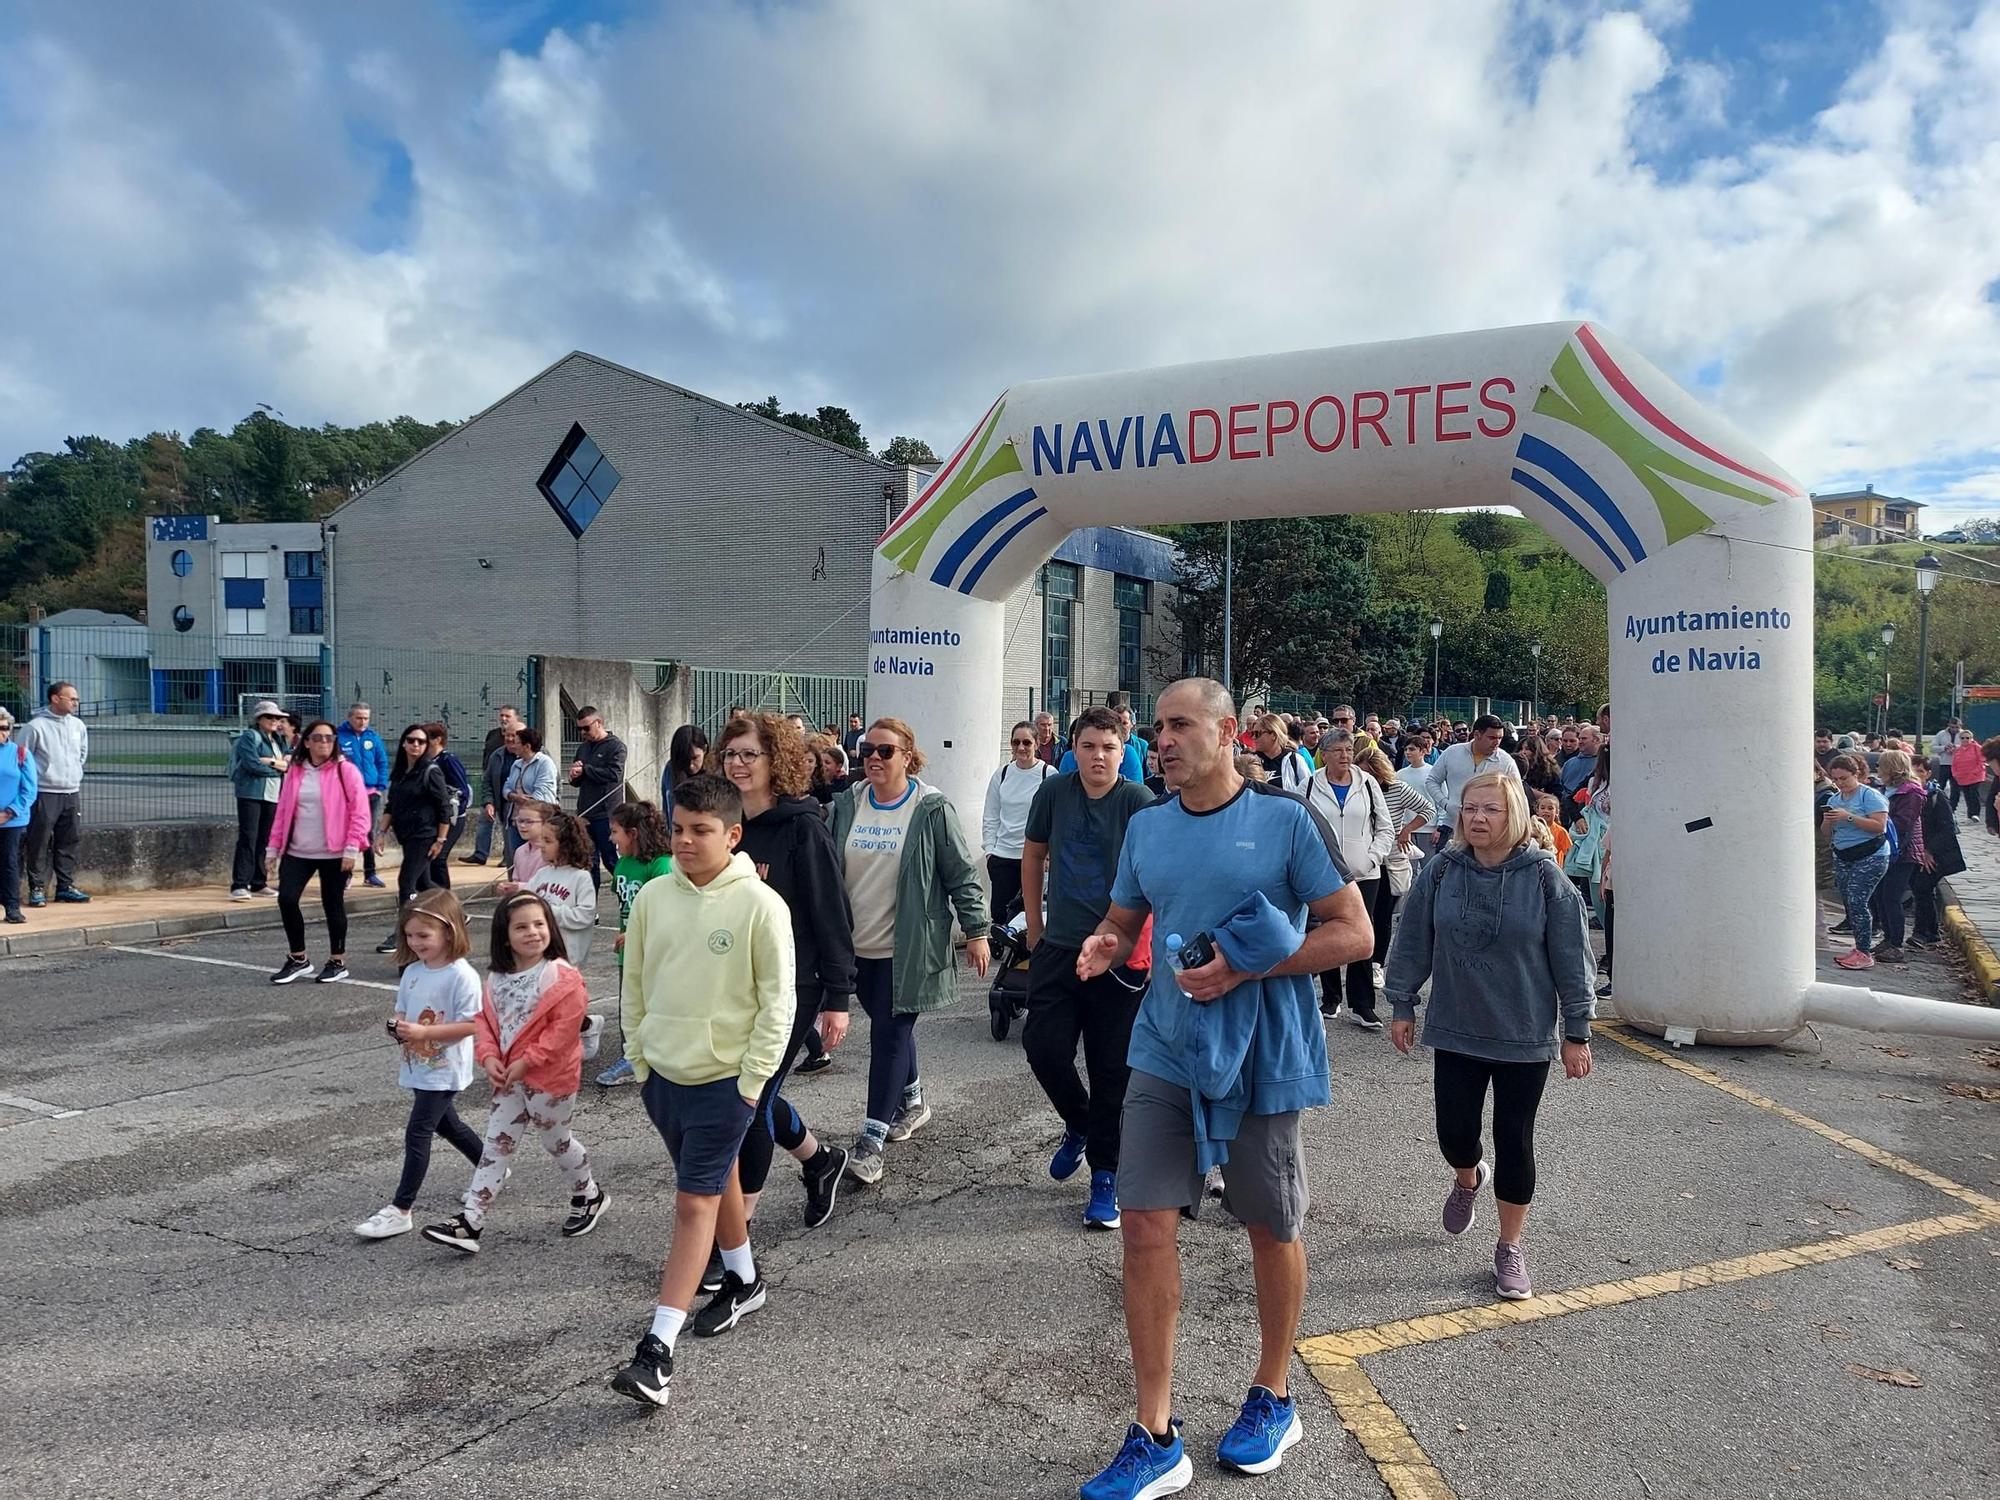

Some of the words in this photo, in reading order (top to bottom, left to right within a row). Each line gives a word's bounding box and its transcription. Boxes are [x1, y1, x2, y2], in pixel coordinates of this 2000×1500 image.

[1626, 605, 1791, 643] Ayuntamiento
[873, 655, 886, 674] de
[889, 656, 934, 676] Navia
[1652, 650, 1681, 674] de
[1689, 646, 1761, 671] Navia
